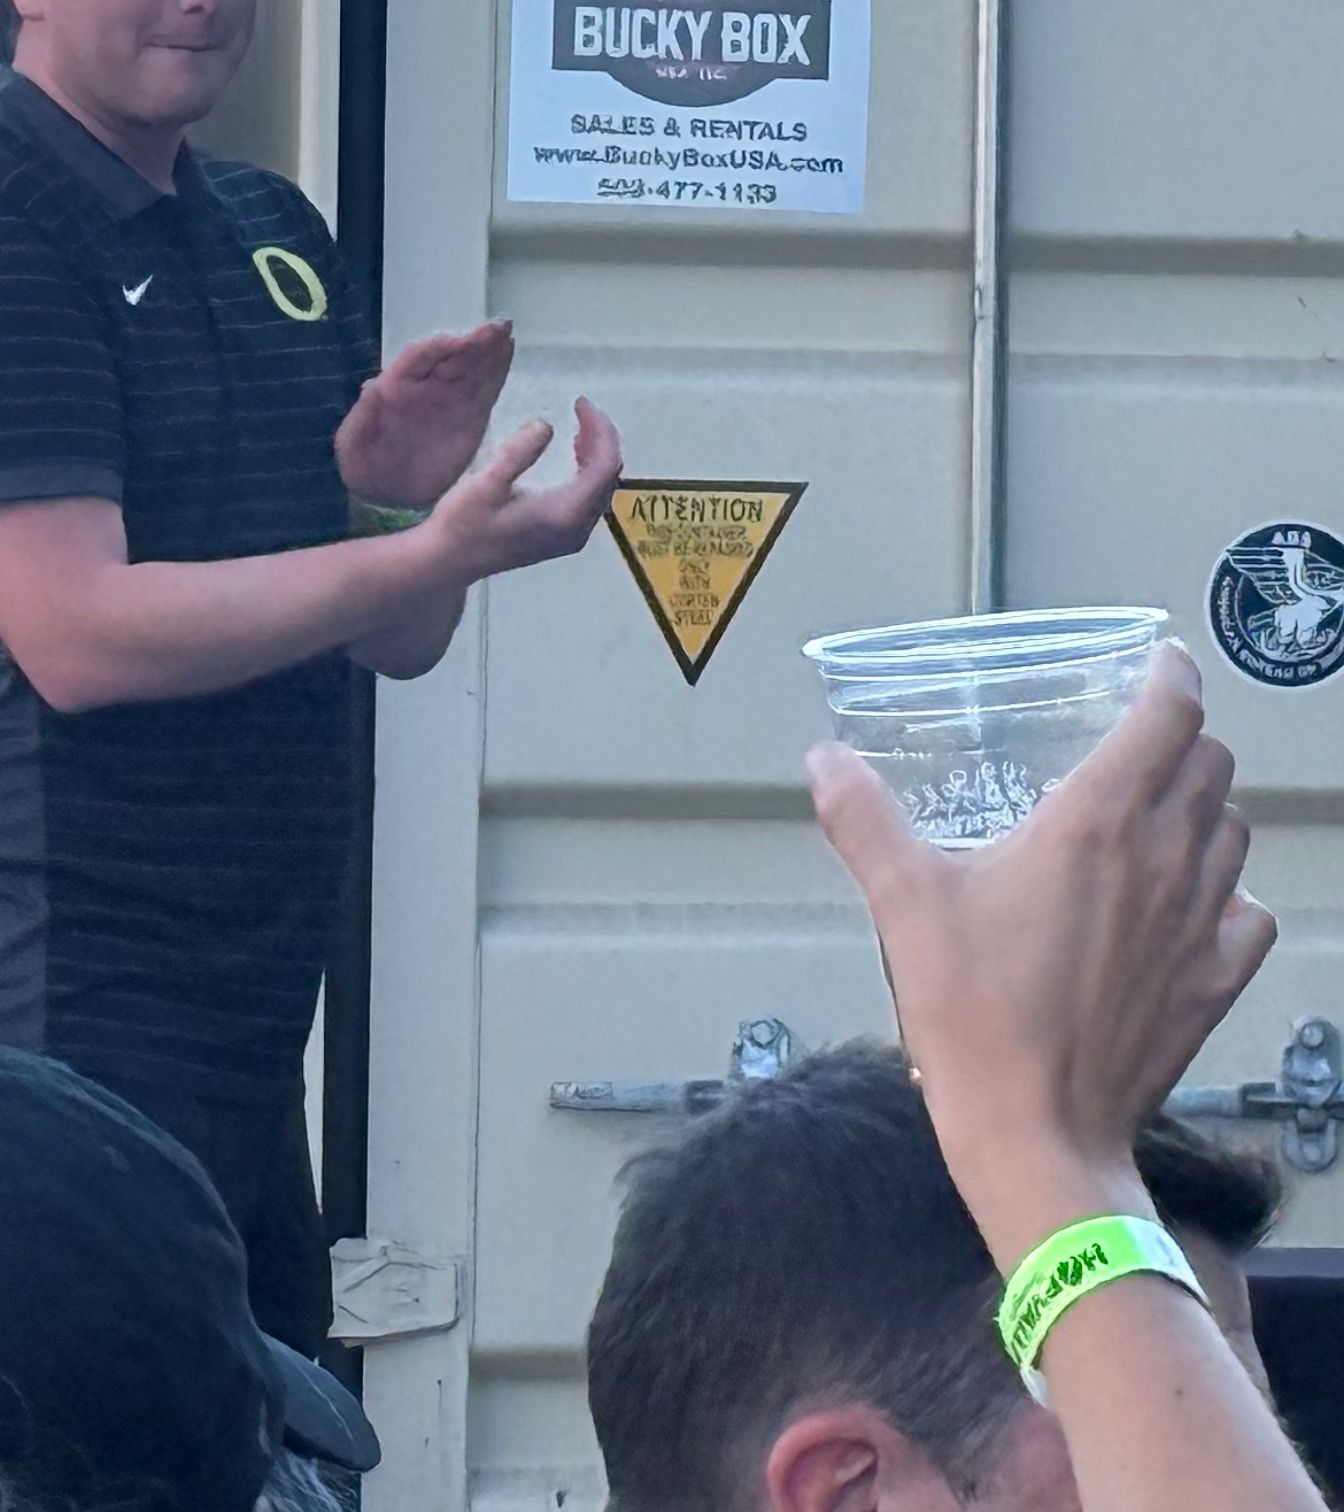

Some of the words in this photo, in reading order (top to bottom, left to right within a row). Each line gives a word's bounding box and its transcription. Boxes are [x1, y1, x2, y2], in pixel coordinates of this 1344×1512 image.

[573, 6, 713, 61] BUCKY
[720, 11, 812, 66] BOX
[570, 113, 656, 137] SALES
[663, 116, 682, 139] &
[690, 118, 808, 143] RENTALS
[630, 493, 763, 523] ATTENTION
